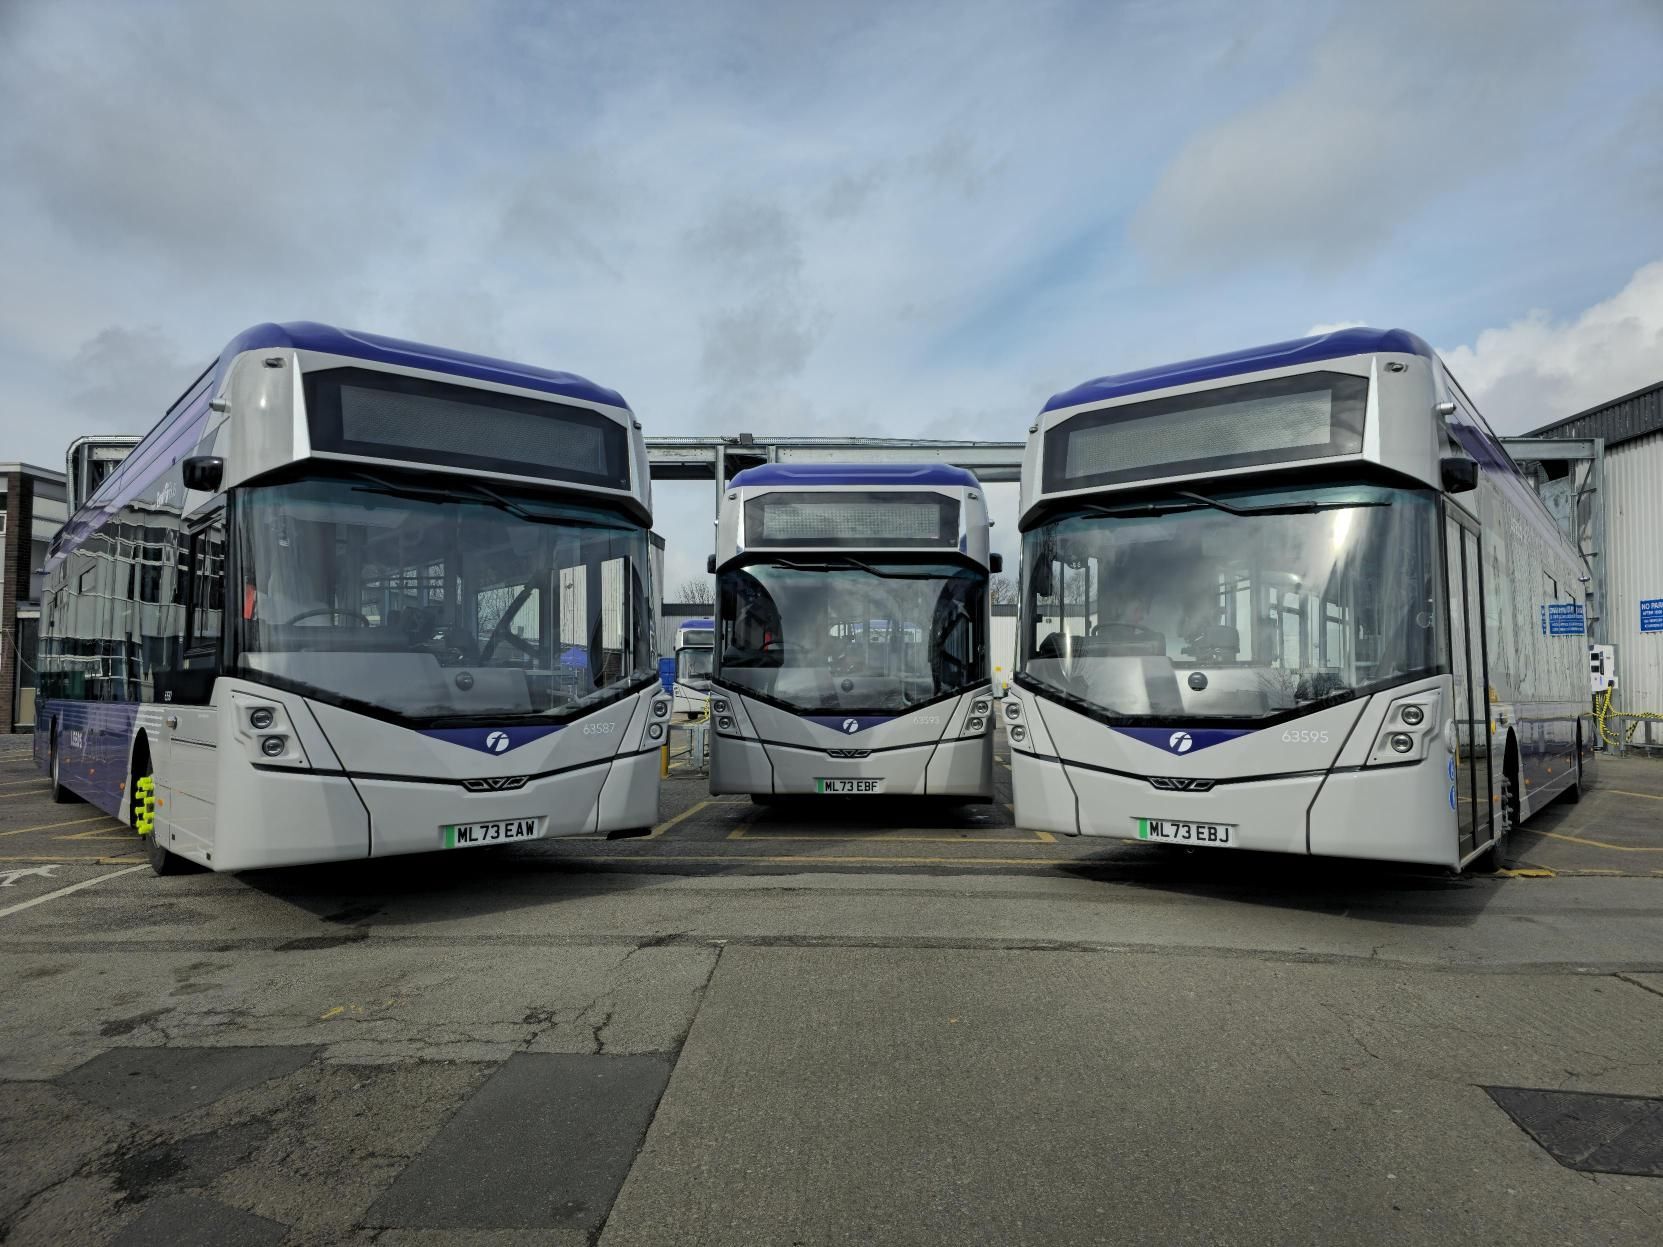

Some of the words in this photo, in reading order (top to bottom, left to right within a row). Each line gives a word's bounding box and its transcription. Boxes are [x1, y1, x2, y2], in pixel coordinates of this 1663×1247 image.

[583, 722, 615, 735] 63587
[1282, 730, 1329, 744] 63595
[825, 781, 854, 792] ML73
[856, 781, 878, 792] EBF
[457, 824, 500, 843] ML73
[505, 820, 535, 838] EAW
[1149, 821, 1192, 840] ML73
[1196, 825, 1229, 843] EBJ
